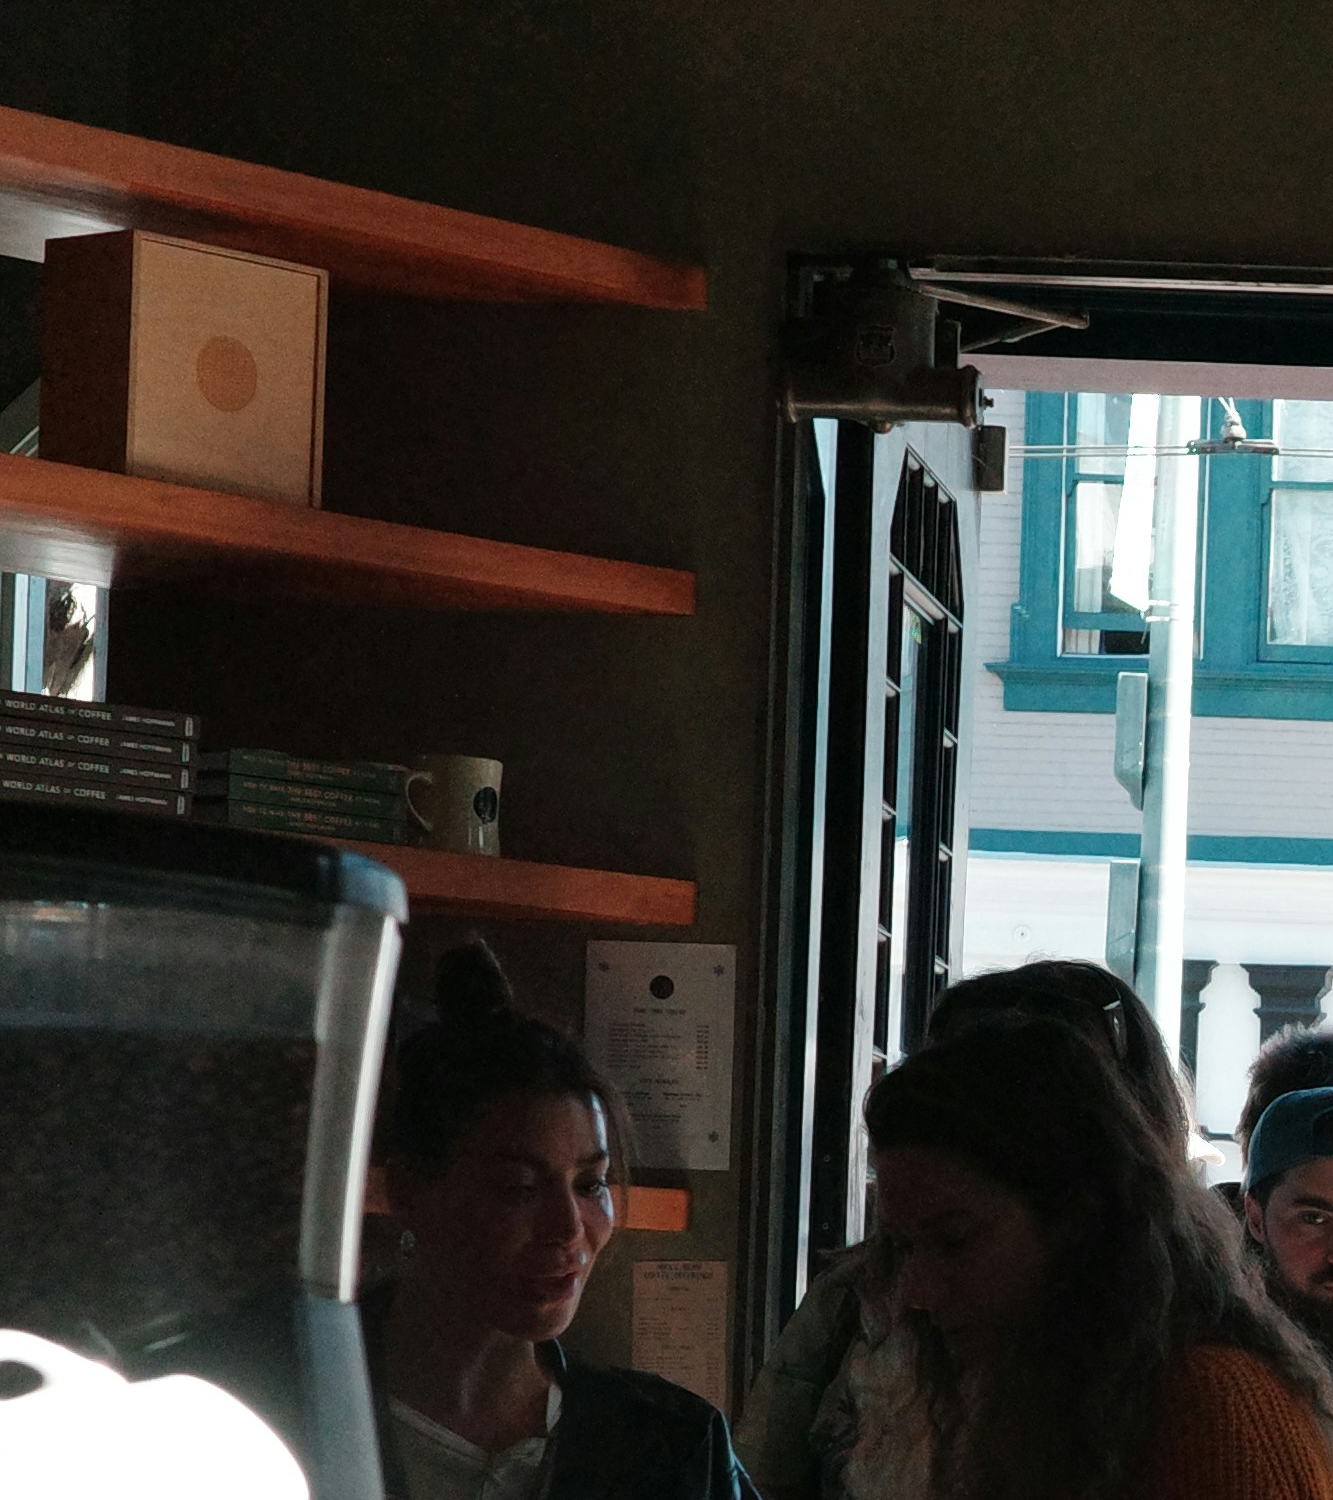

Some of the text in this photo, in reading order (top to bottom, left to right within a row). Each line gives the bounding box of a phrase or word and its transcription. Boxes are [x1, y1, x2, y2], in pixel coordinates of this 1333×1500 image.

[5, 699, 36, 711] WORLD
[38, 703, 65, 715] ATLAS
[78, 709, 112, 721] COFFEE
[5, 726, 36, 737] WORLD
[38, 729, 64, 741] ATLAS
[77, 735, 110, 747] COFFEE
[6, 753, 36, 764] WORLD
[39, 757, 64, 768] ATLAS
[77, 762, 110, 774] COFFEE
[3, 779, 33, 791] WORLD
[35, 783, 61, 794] ATLAS
[73, 788, 106, 800] COFFEE
